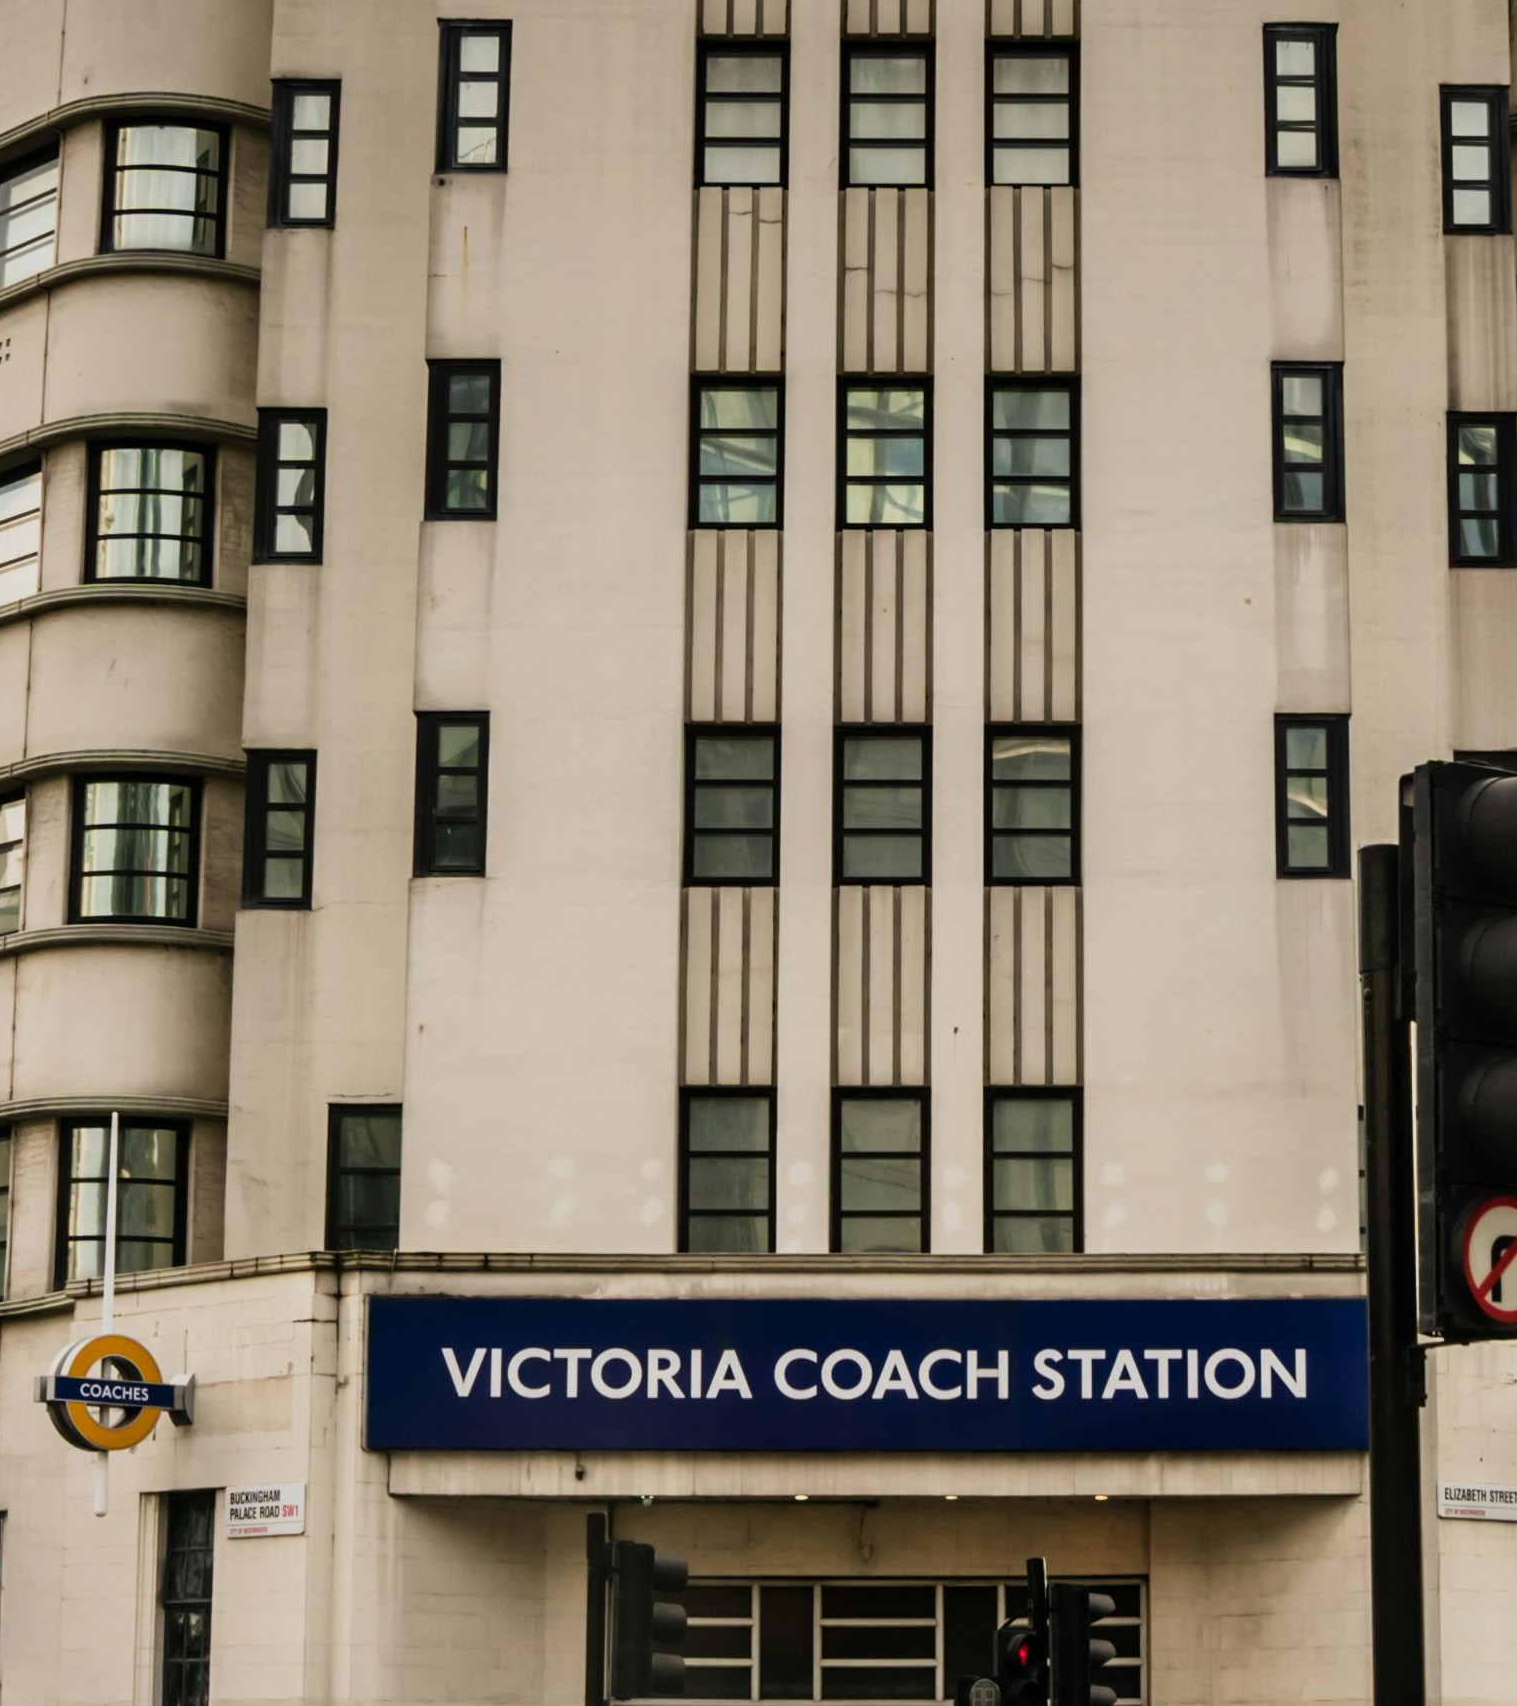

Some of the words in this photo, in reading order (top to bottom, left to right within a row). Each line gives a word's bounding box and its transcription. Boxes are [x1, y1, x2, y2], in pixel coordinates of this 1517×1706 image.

[441, 1347, 753, 1399] VICTORIA
[773, 1347, 1010, 1400] COACH
[1030, 1347, 1307, 1400] STATION
[79, 1382, 149, 1402] COACHES
[229, 1489, 281, 1505] BUCKINGHAM
[1444, 1487, 1487, 1502] ELIZABETH
[1489, 1489, 1517, 1504] STREET
[229, 1506, 257, 1521] PALACE
[259, 1504, 280, 1519] ROAD
[282, 1503, 299, 1517] SW1
